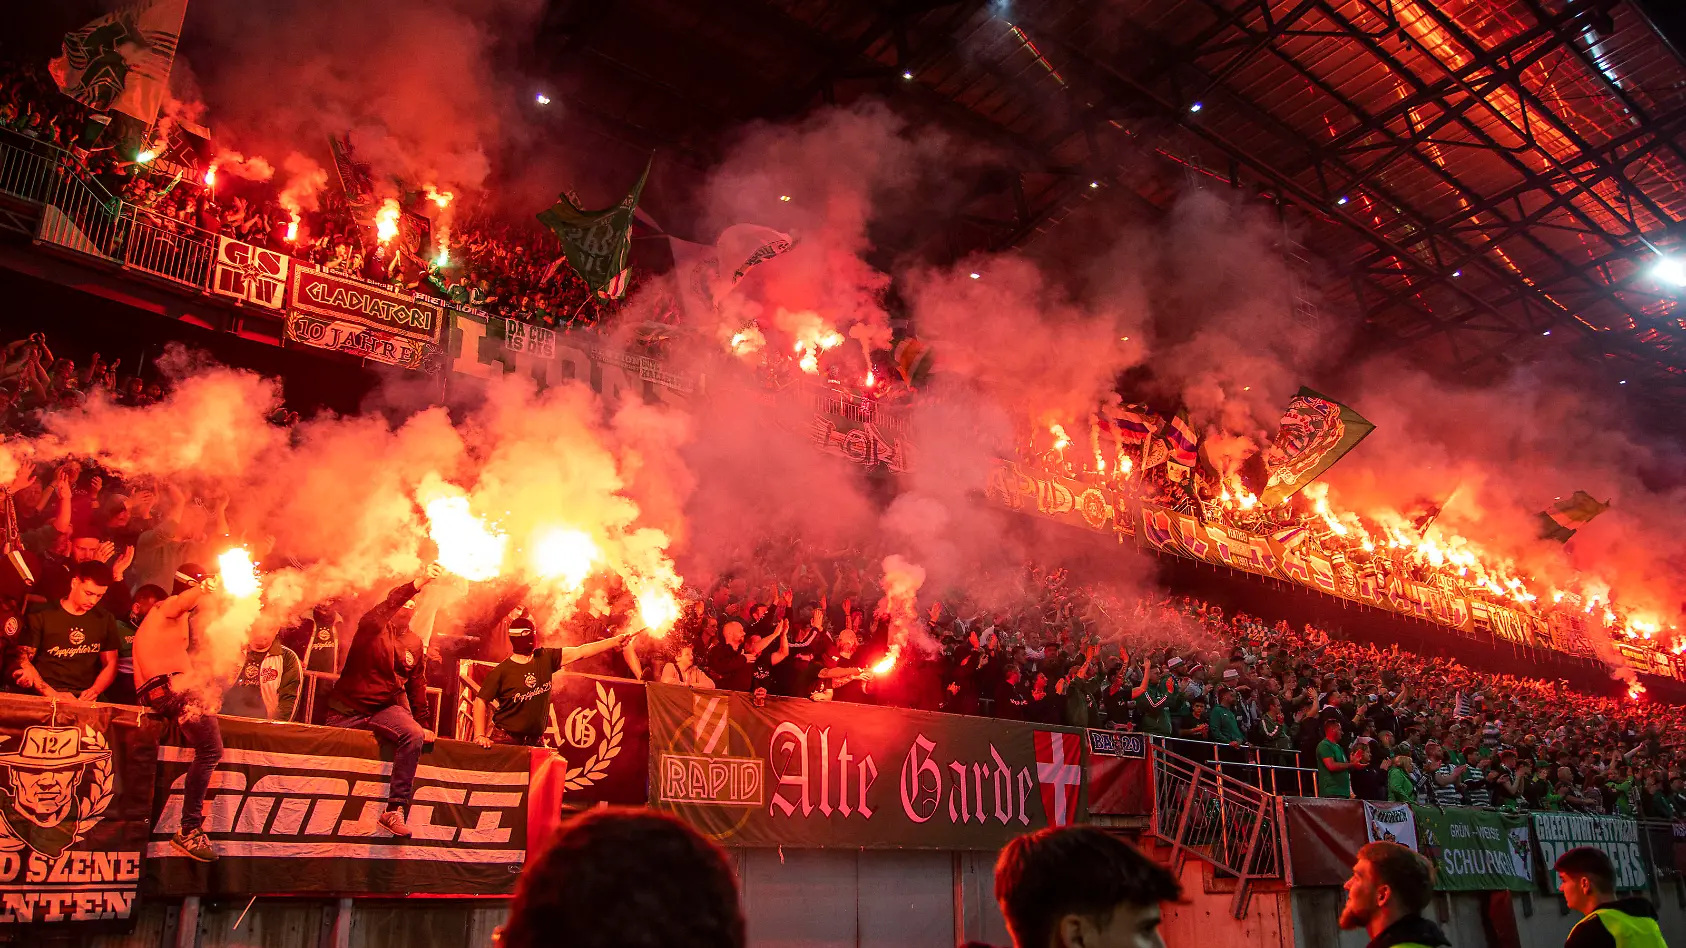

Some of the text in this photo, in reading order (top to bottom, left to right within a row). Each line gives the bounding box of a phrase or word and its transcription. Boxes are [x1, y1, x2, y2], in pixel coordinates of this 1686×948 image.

[305, 281, 431, 330] GLADIATORI
[508, 319, 526, 337] DA
[299, 318, 414, 363] 10 JAHRE
[40, 735, 59, 756] 12
[664, 756, 760, 801] RAPID
[769, 720, 1034, 827] Alte Garde
[1535, 815, 1570, 841] GREEN
[26, 851, 141, 882] SZENE
[1540, 841, 1647, 888] PERS
